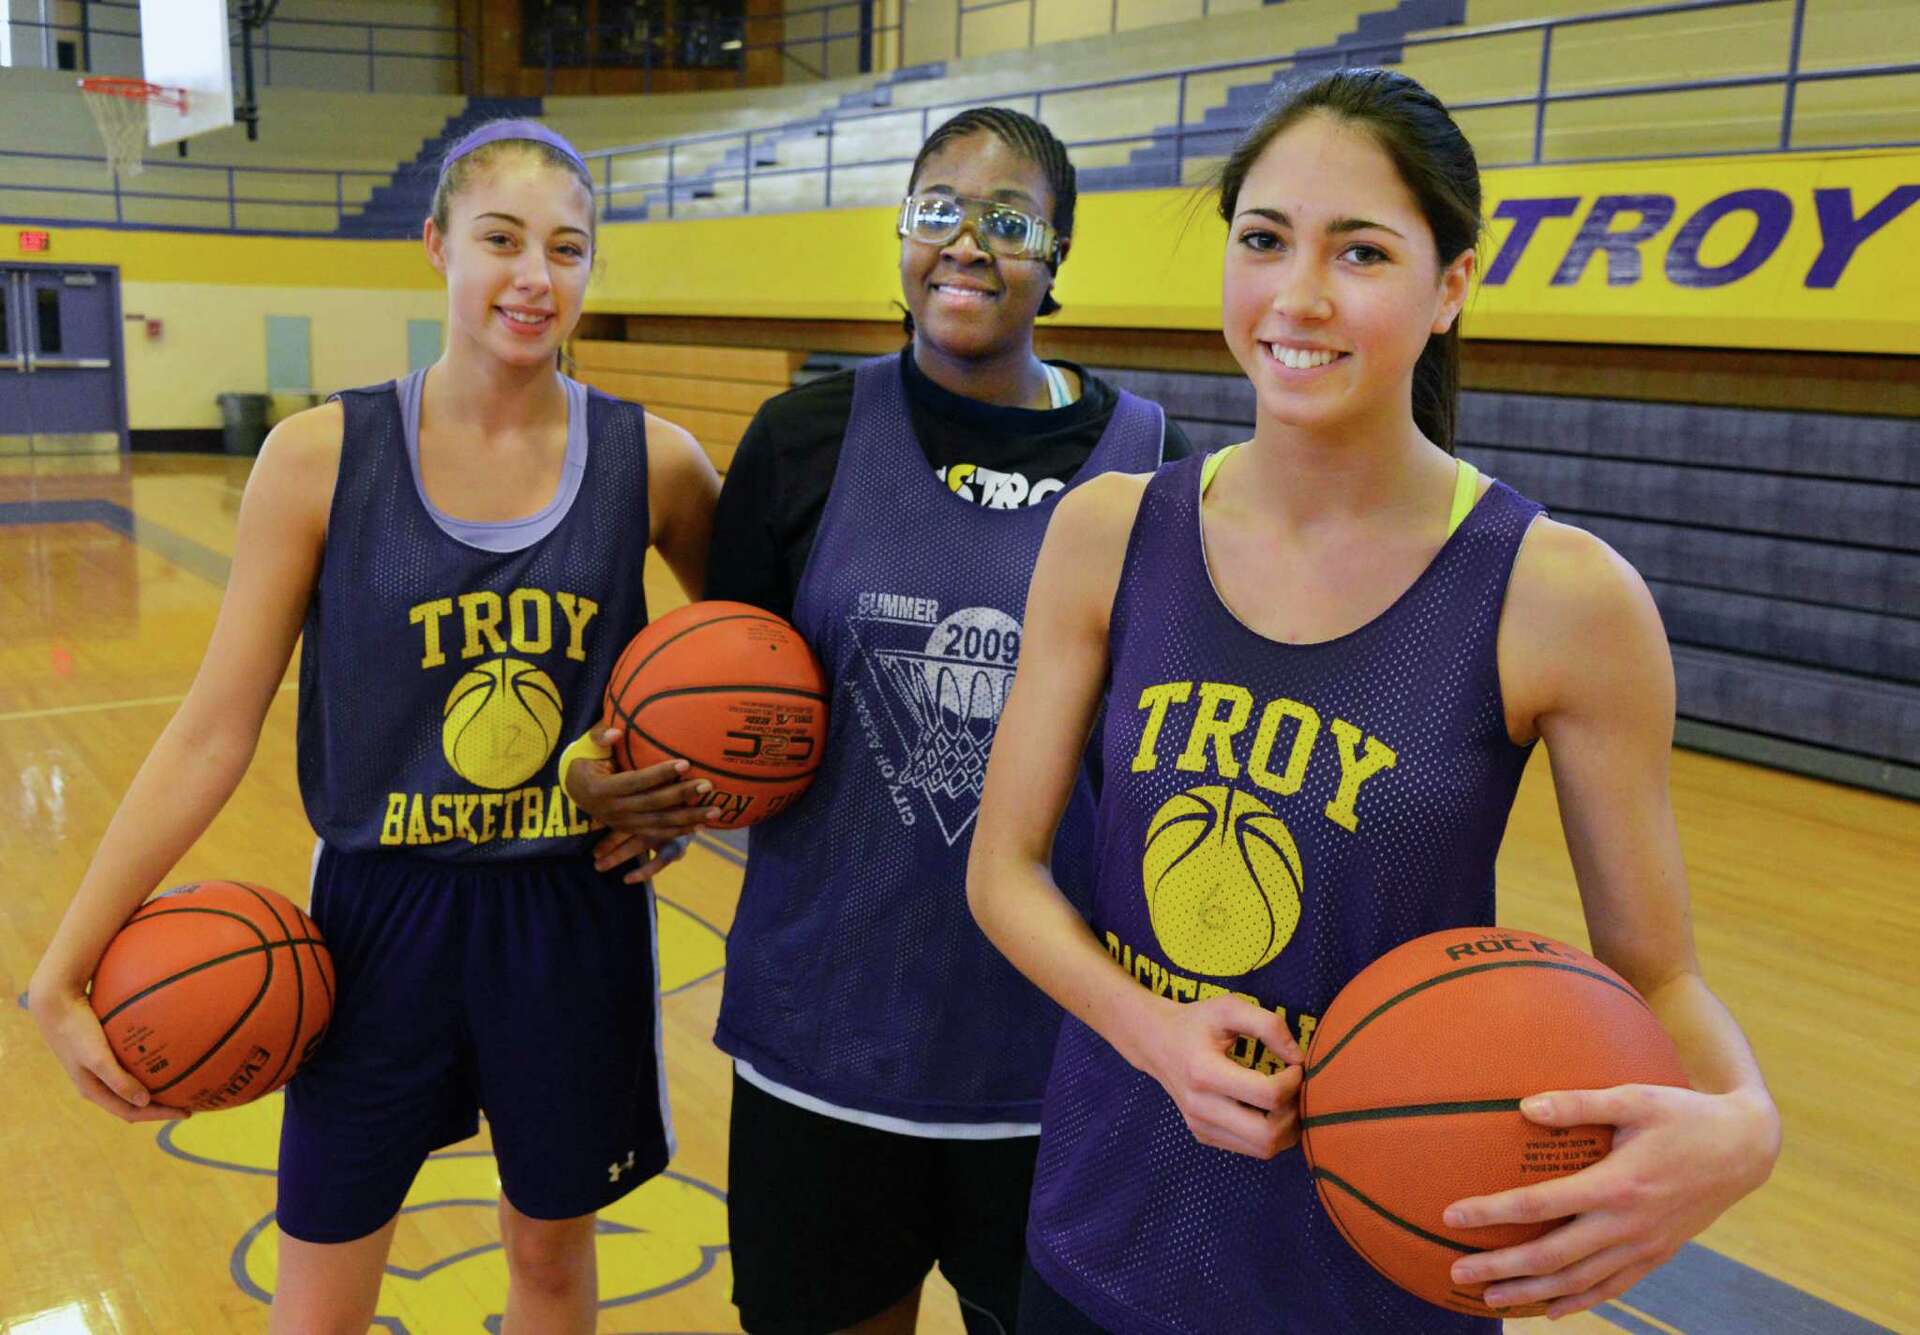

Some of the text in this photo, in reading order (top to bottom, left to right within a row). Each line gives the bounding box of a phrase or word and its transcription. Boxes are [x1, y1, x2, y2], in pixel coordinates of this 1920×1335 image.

[1481, 184, 1920, 290] TROY
[857, 592, 939, 622] SUMMER
[408, 587, 598, 670] TROY
[943, 624, 1020, 663] 2009
[874, 754, 895, 778] OF
[1130, 681, 1398, 833] TROY
[379, 785, 603, 845] BASKETBAL
[888, 784, 916, 826] CITY
[1445, 938, 1563, 961] ROCK
